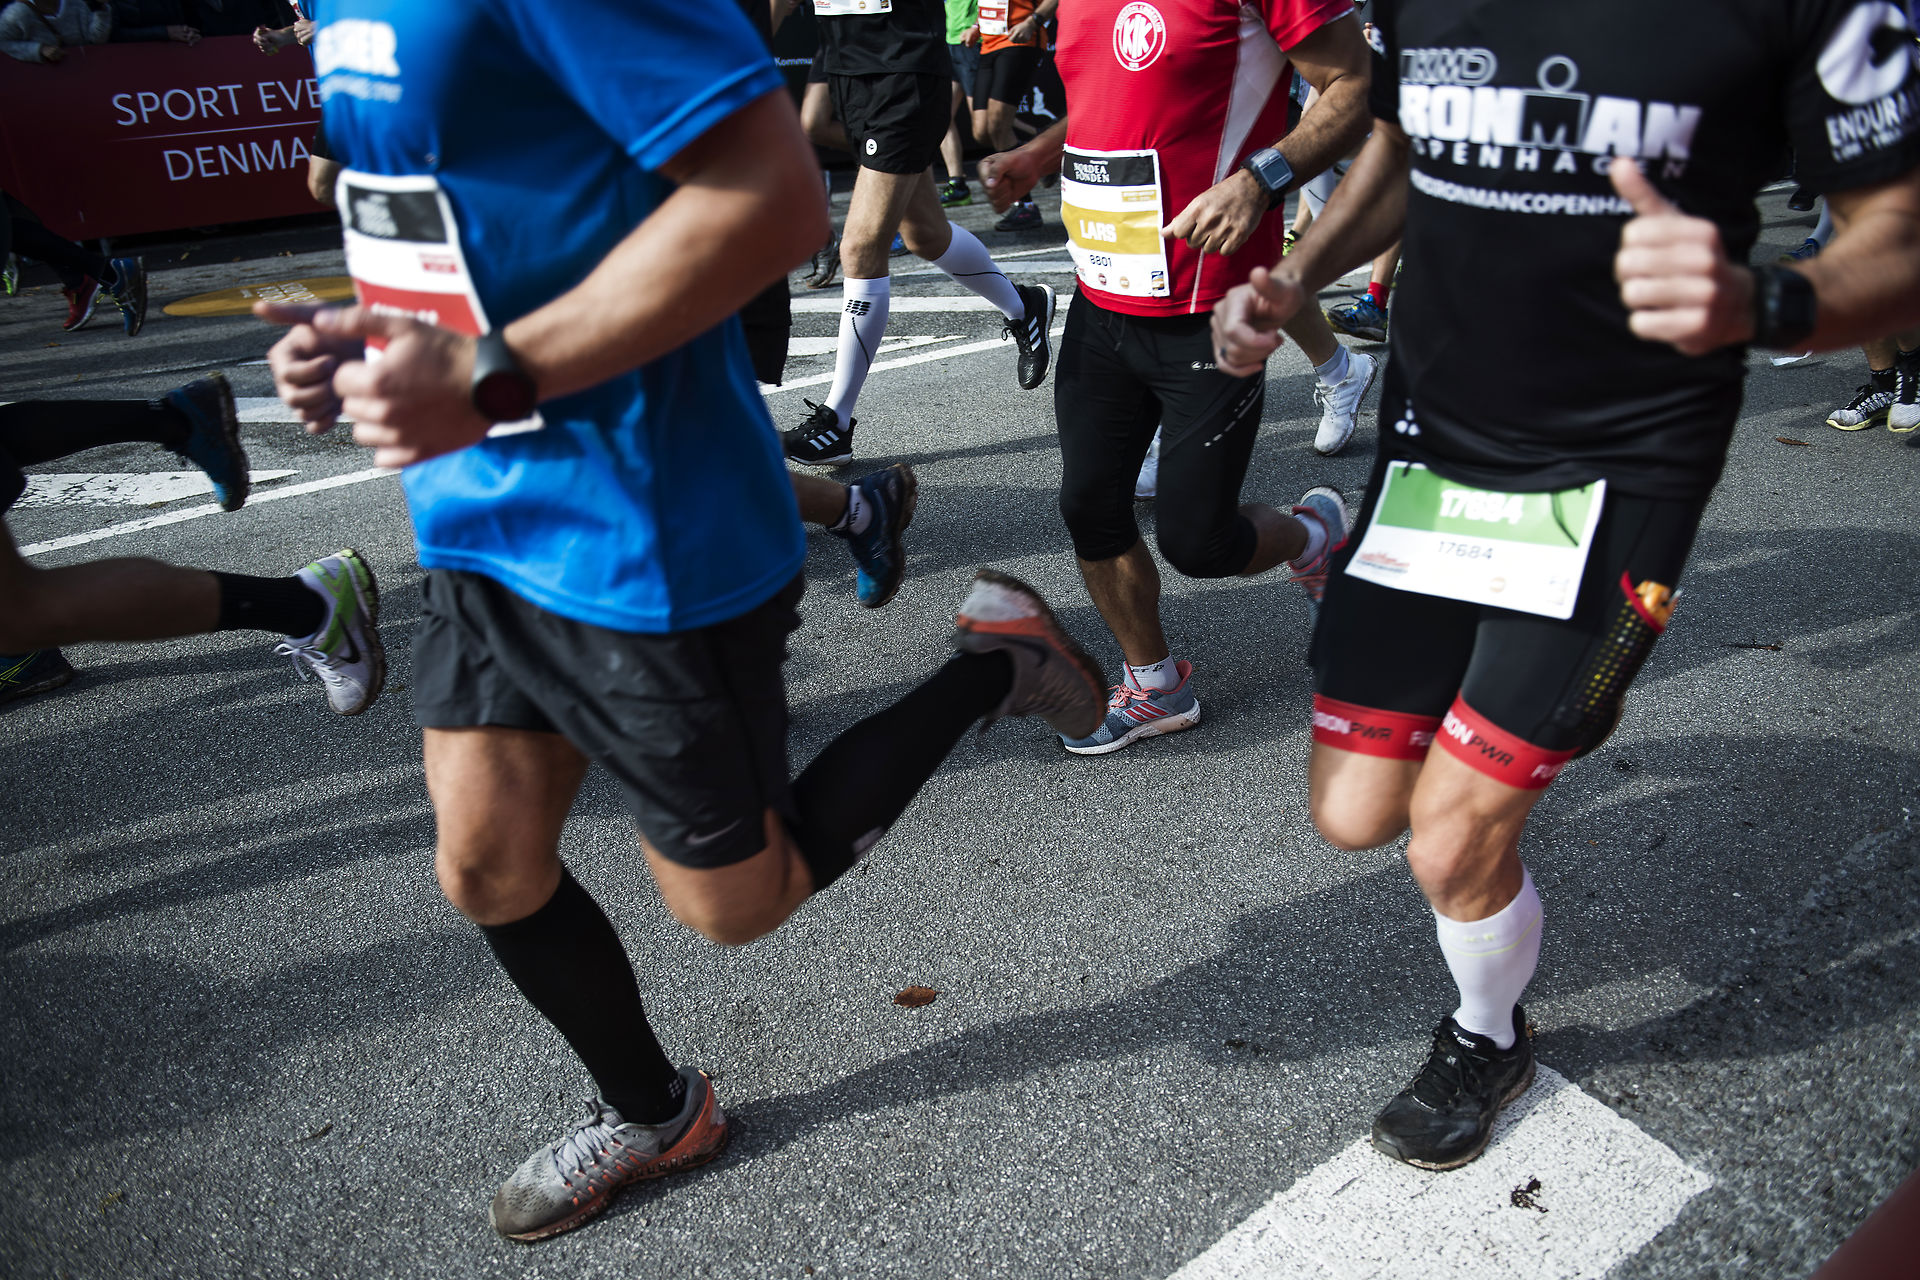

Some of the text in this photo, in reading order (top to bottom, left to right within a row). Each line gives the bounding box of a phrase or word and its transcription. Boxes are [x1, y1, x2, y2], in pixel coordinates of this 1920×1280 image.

[774, 56, 813, 66] Kommu
[112, 83, 243, 126] SPORT
[257, 78, 322, 113] EVE
[1399, 82, 1702, 161] RONMAN
[163, 136, 312, 181] DENMA
[1073, 162, 1107, 175] NORDEA
[1079, 219, 1117, 243] LARS
[1089, 254, 1112, 268] 8801
[1438, 541, 1494, 560] 17684
